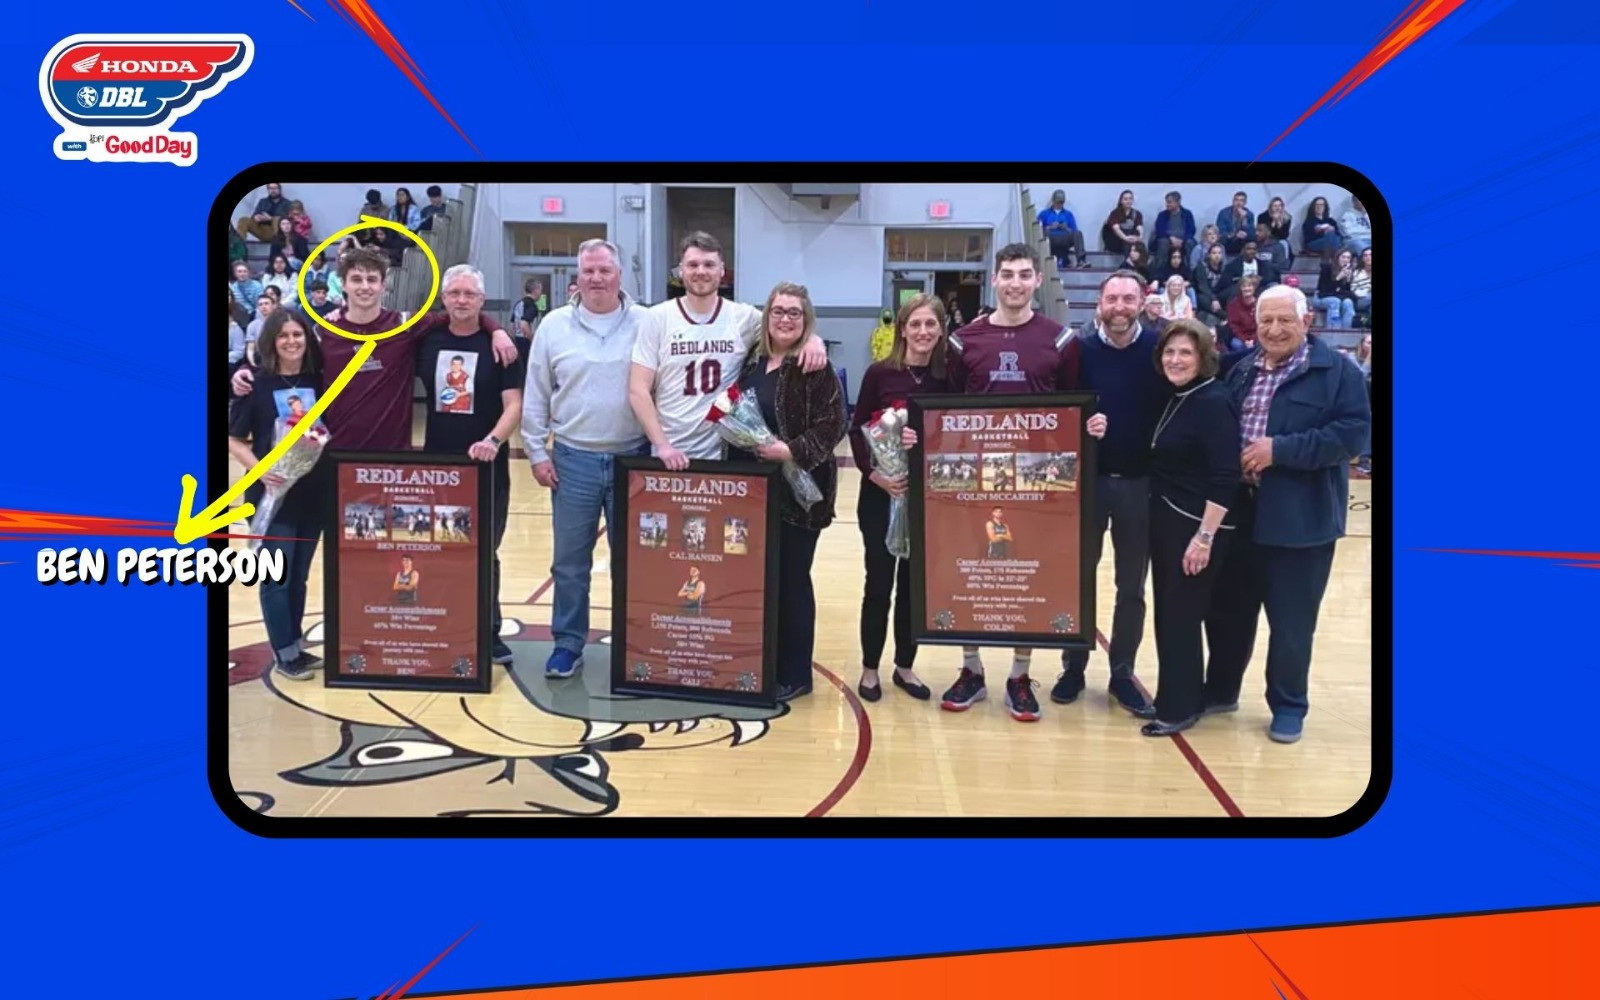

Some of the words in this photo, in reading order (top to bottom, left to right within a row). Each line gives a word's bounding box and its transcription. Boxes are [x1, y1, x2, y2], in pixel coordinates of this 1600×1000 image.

[671, 340, 734, 356] REDLANDS
[999, 351, 1019, 371] R
[683, 359, 722, 396] 10
[941, 413, 1058, 432] REDLANDS
[971, 432, 1030, 440] BASKETBALL
[355, 468, 461, 486] REDLANDS
[383, 486, 435, 494] BASKETBALL
[644, 476, 748, 497] REDLANDS
[671, 495, 723, 504] BASKETBALL
[956, 492, 989, 501] COLIN
[376, 542, 395, 550] BEN
[396, 543, 442, 551] PETERSON
[669, 552, 687, 561] CAL
[688, 553, 723, 562] HANSEN
[972, 614, 1003, 622] THANK
[382, 658, 411, 666] THANK
[667, 667, 695, 676] THANK
